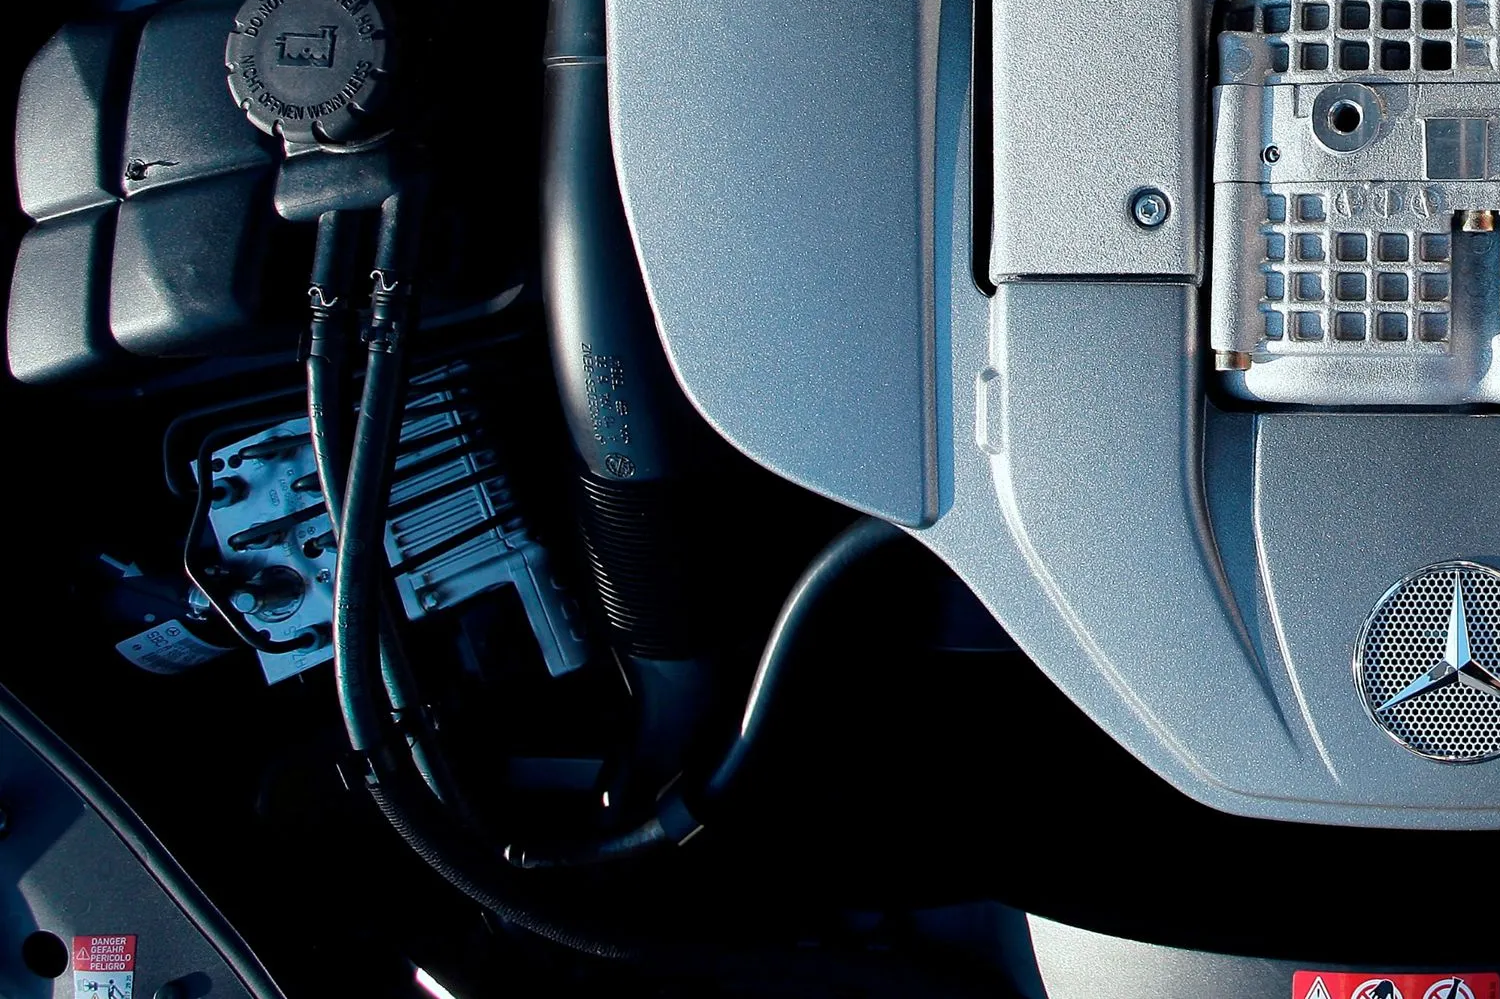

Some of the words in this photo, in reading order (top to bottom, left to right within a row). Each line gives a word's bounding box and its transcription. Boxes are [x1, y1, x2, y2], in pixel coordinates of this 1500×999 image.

[243, 16, 264, 38] DO
[240, 55, 265, 94] NICHT
[307, 100, 343, 120] WENN
[340, 60, 373, 100] HEISS
[91, 936, 127, 946] DANGER
[90, 945, 124, 954] GEFAHR
[90, 953, 132, 962] PERICOLO
[89, 962, 126, 971] PELIGRO
